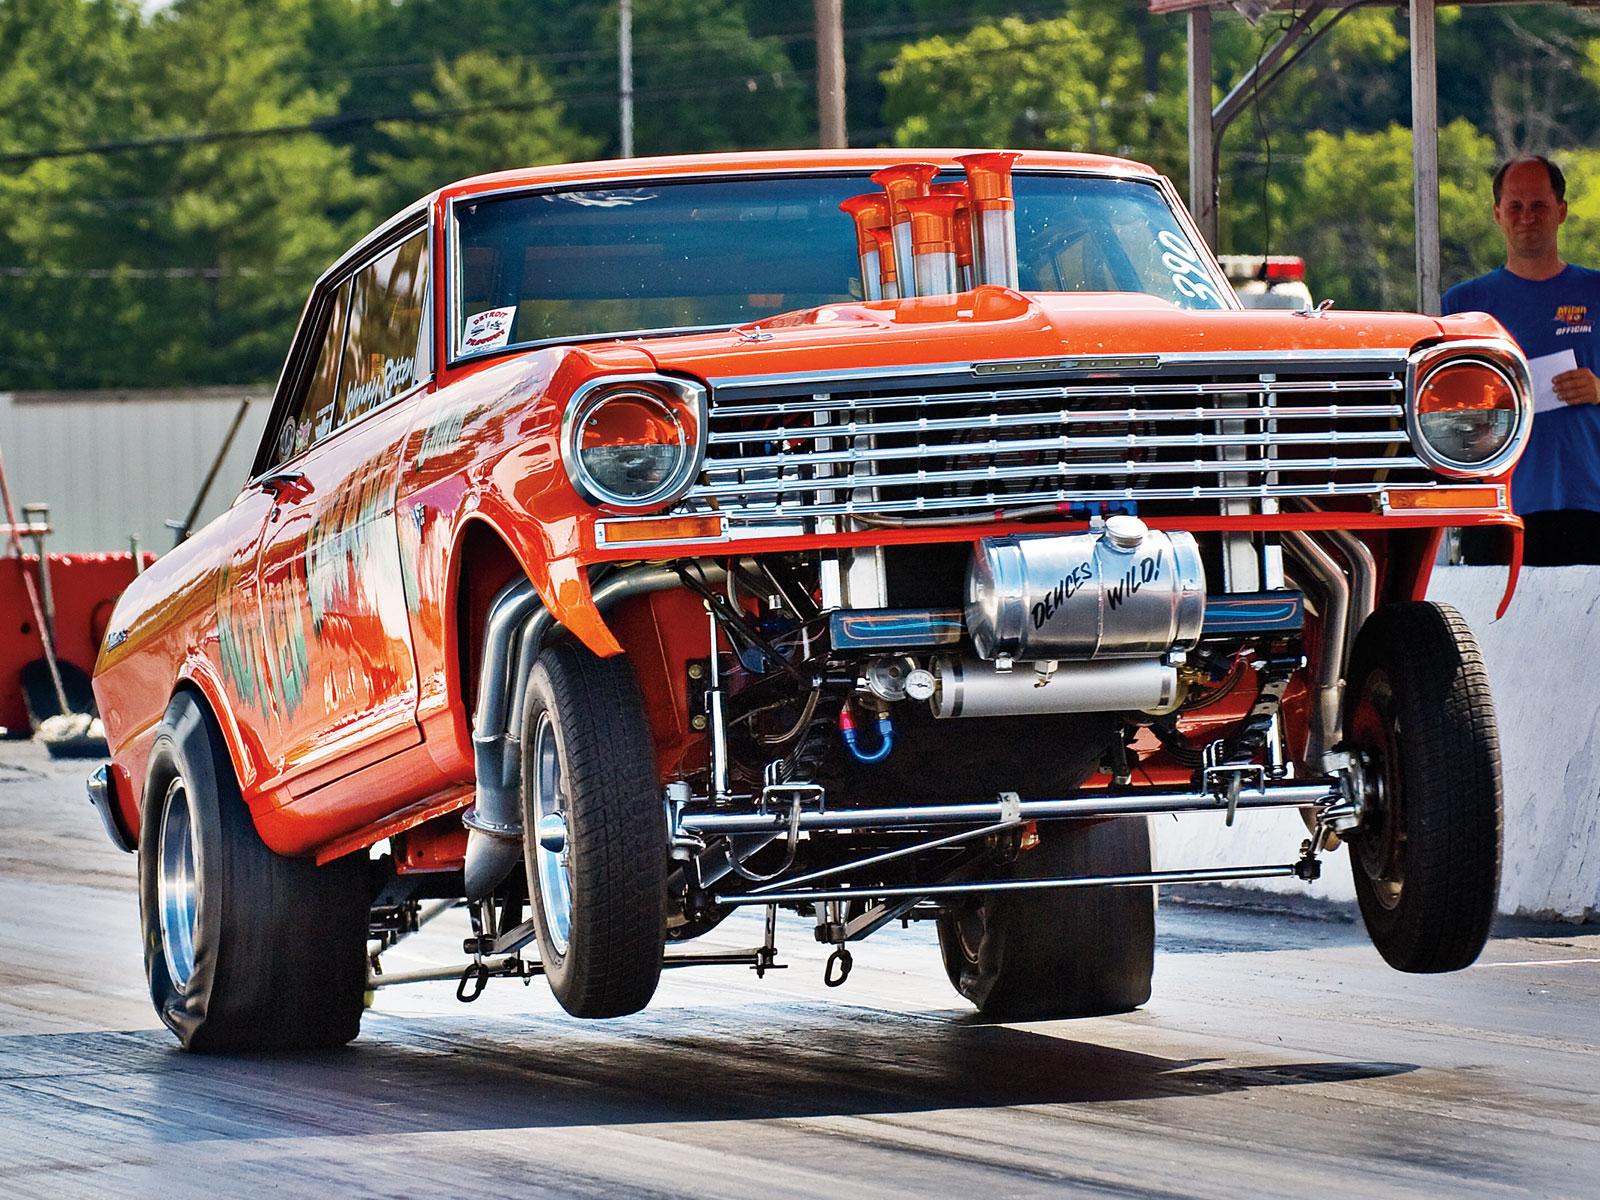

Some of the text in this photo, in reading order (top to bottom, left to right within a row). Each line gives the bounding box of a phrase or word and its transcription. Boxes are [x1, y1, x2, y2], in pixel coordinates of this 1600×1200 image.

[1158, 230, 1224, 309] 390
[473, 311, 508, 335] DETROIT
[1556, 325, 1591, 335] OFFICIAL
[1031, 549, 1162, 630] DEUCES WILD!
